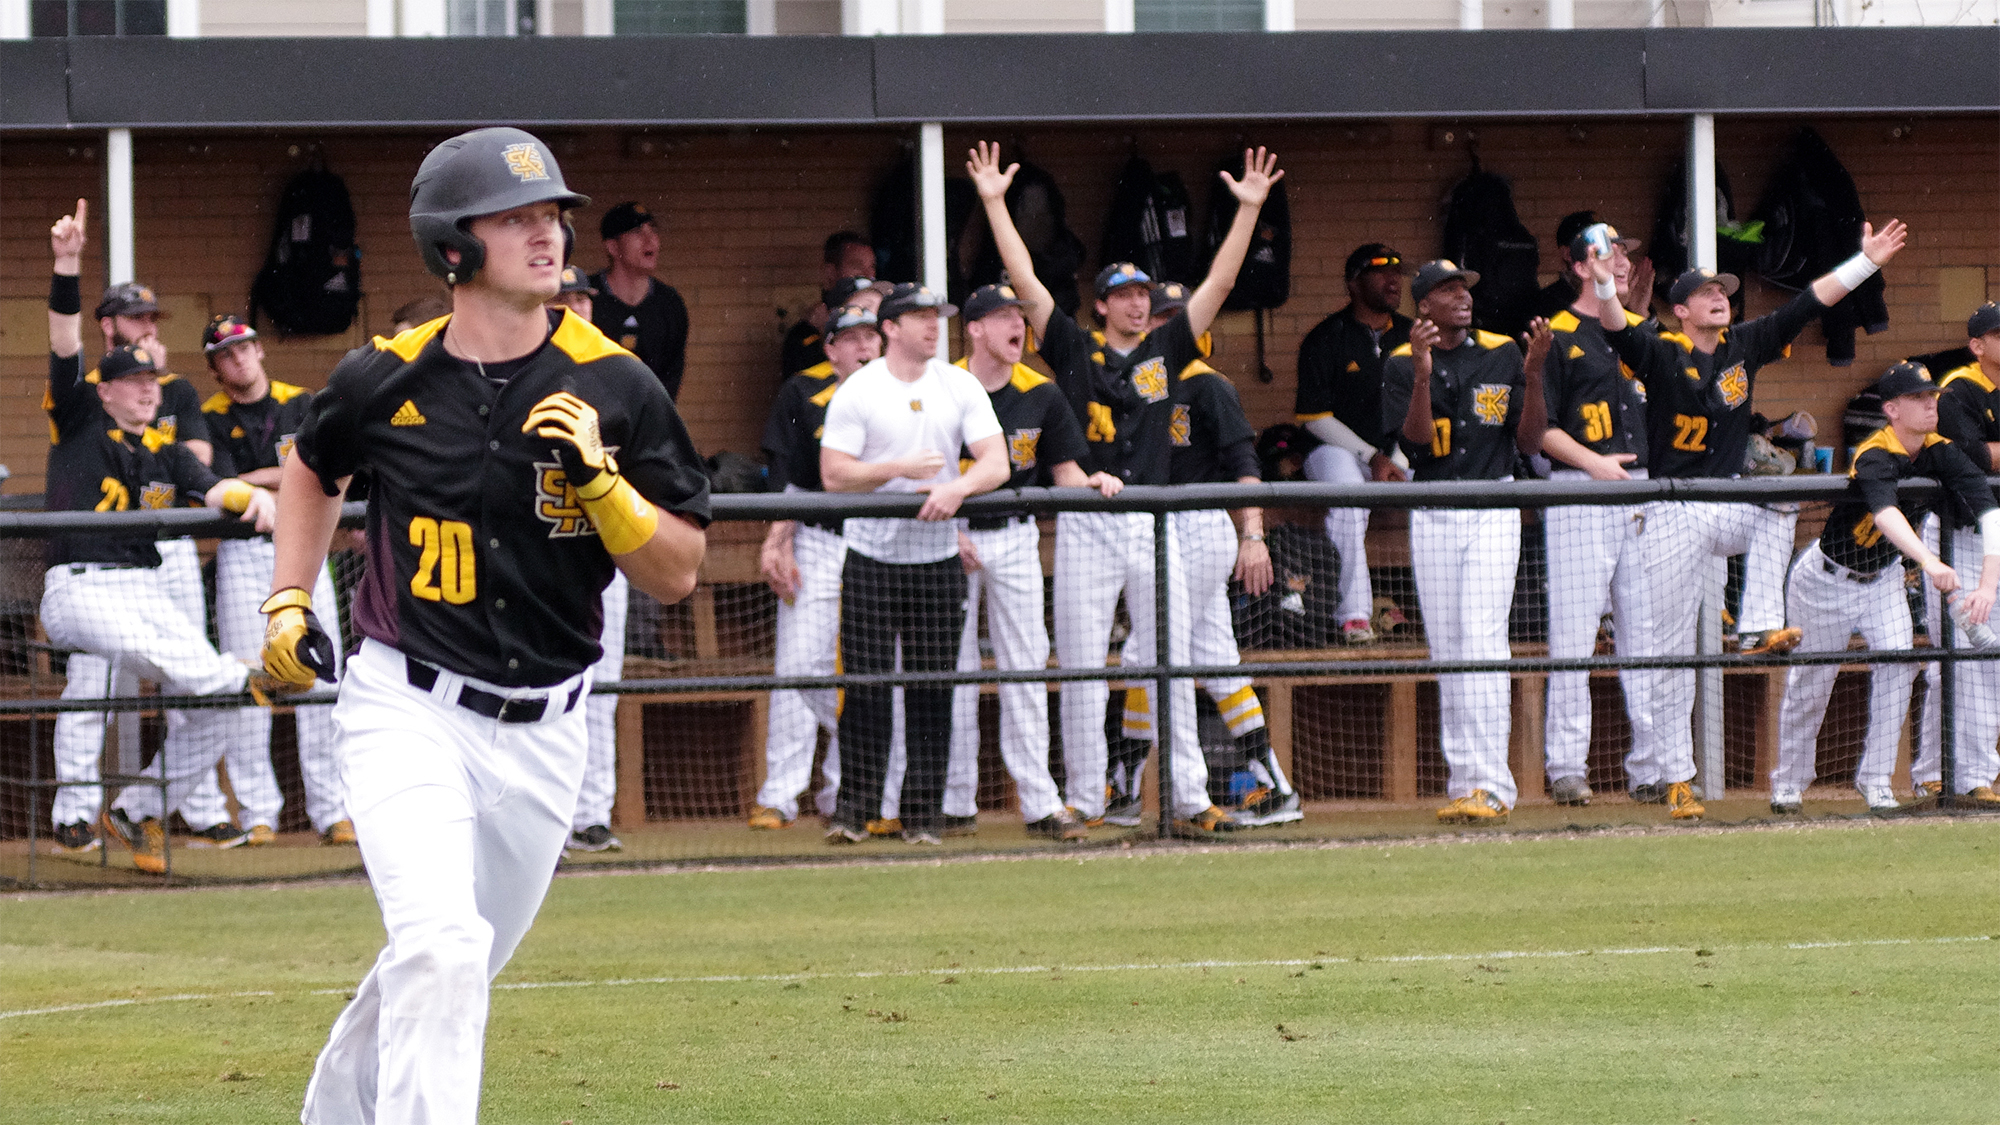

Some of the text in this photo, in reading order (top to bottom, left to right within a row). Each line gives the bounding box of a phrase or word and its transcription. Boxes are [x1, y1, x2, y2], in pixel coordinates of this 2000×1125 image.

[1582, 399, 1614, 442] 31
[1672, 413, 1709, 453] 22
[409, 515, 478, 606] 20
